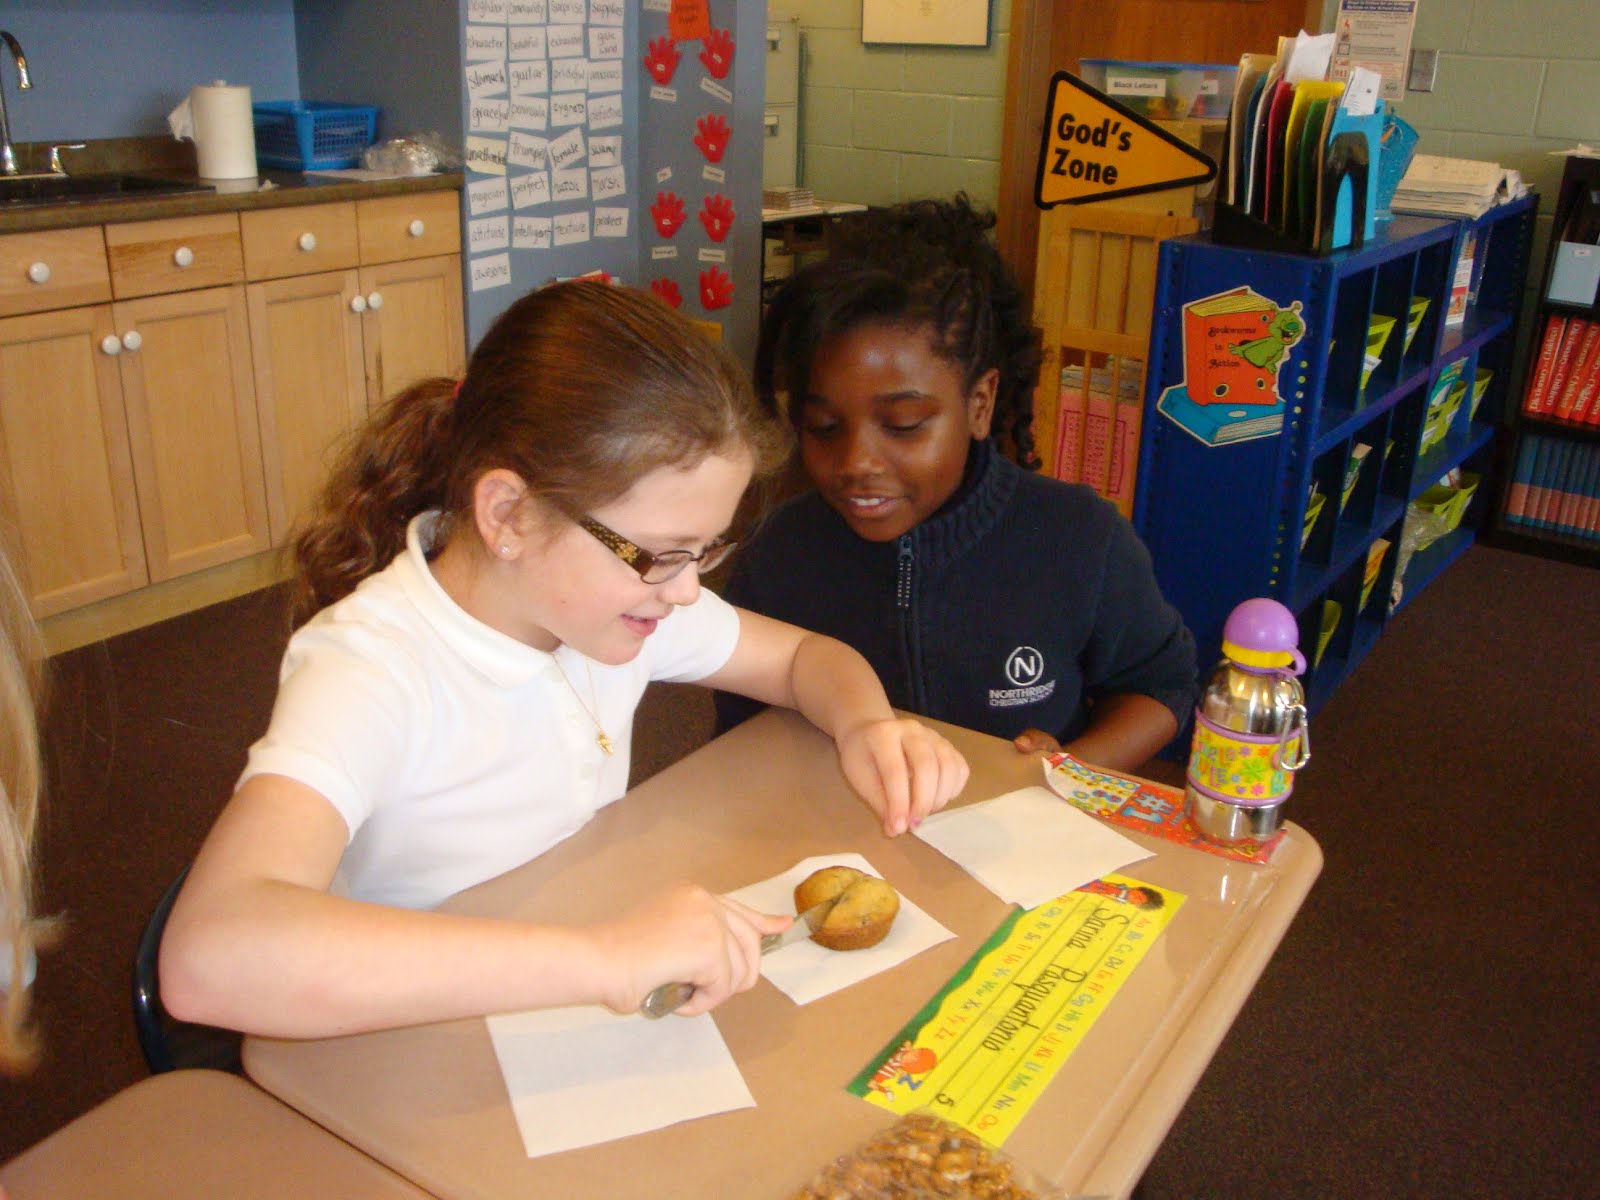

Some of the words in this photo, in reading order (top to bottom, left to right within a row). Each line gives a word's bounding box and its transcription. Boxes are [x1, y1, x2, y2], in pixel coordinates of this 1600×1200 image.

[1057, 112, 1132, 152] God's
[1050, 148, 1119, 186] Zone
[1015, 656, 1036, 678] N
[1066, 908, 1130, 949] Sarina
[982, 963, 1088, 1051] Pasquantonio
[935, 1093, 955, 1108] 5
